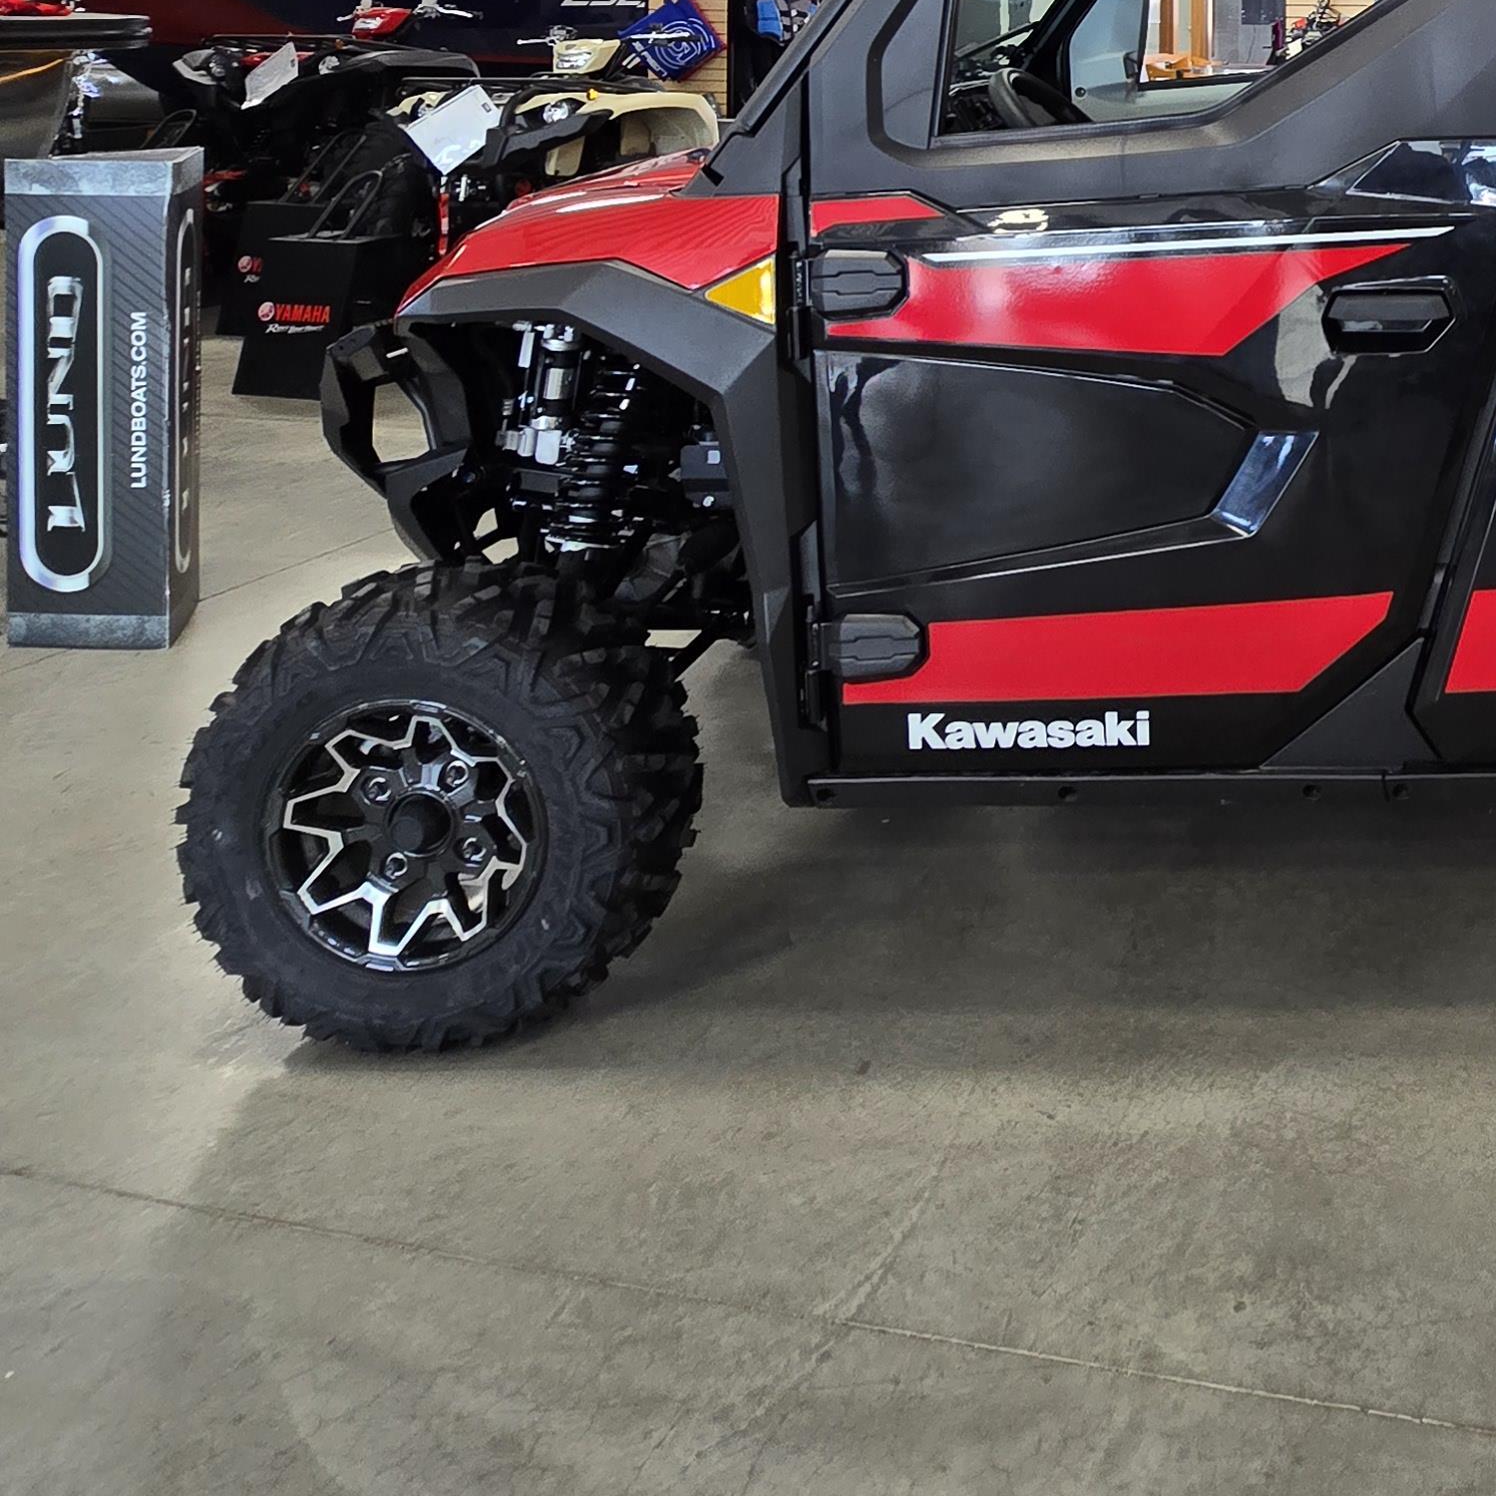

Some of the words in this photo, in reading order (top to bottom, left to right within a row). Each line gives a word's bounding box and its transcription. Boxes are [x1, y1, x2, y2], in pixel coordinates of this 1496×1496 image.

[275, 303, 331, 323] YAMAHA
[47, 276, 85, 533] LUND
[130, 311, 147, 489] LUNDBOATS.COM
[907, 710, 1150, 750] Kawasaki
